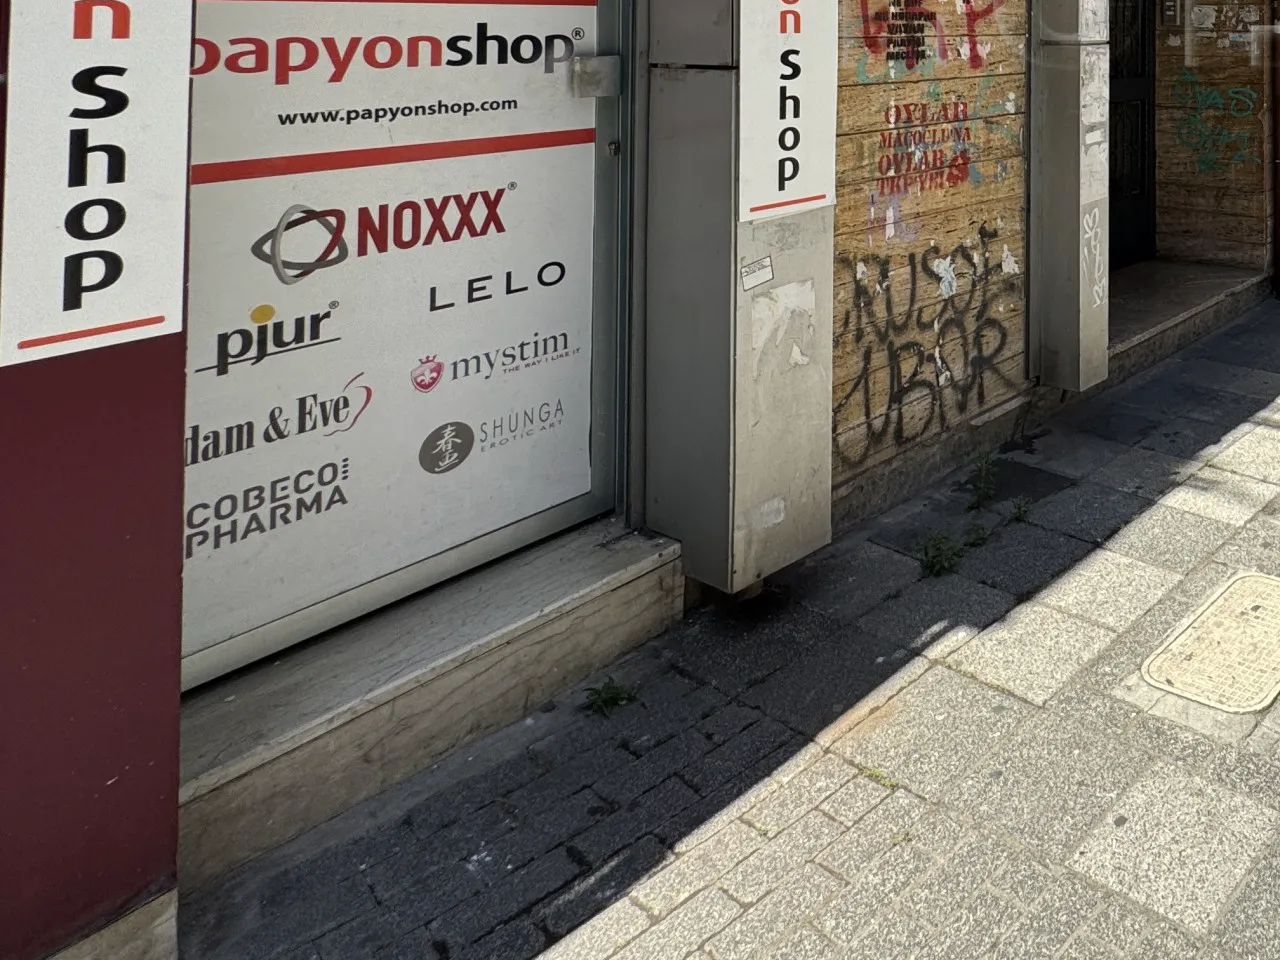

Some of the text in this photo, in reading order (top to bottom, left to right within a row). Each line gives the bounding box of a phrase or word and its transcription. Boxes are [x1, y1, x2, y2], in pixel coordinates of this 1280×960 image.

[192, 22, 575, 86] papyonshop
[277, 98, 518, 127] www.papyonshop.com
[356, 187, 507, 258] NOXXX
[429, 260, 566, 313] LELO
[216, 304, 332, 377] pjur
[450, 331, 570, 382] mystim
[502, 365, 521, 375] THE
[524, 359, 542, 368] WAY
[551, 351, 570, 361] LIKE
[572, 347, 581, 356] IT
[262, 405, 291, 444] &
[295, 393, 350, 436] Eve
[479, 397, 565, 444] SHUNGA
[480, 419, 563, 453] EROTIC ART
[186, 461, 339, 530] COBECO
[184, 484, 349, 560] PHARMA
